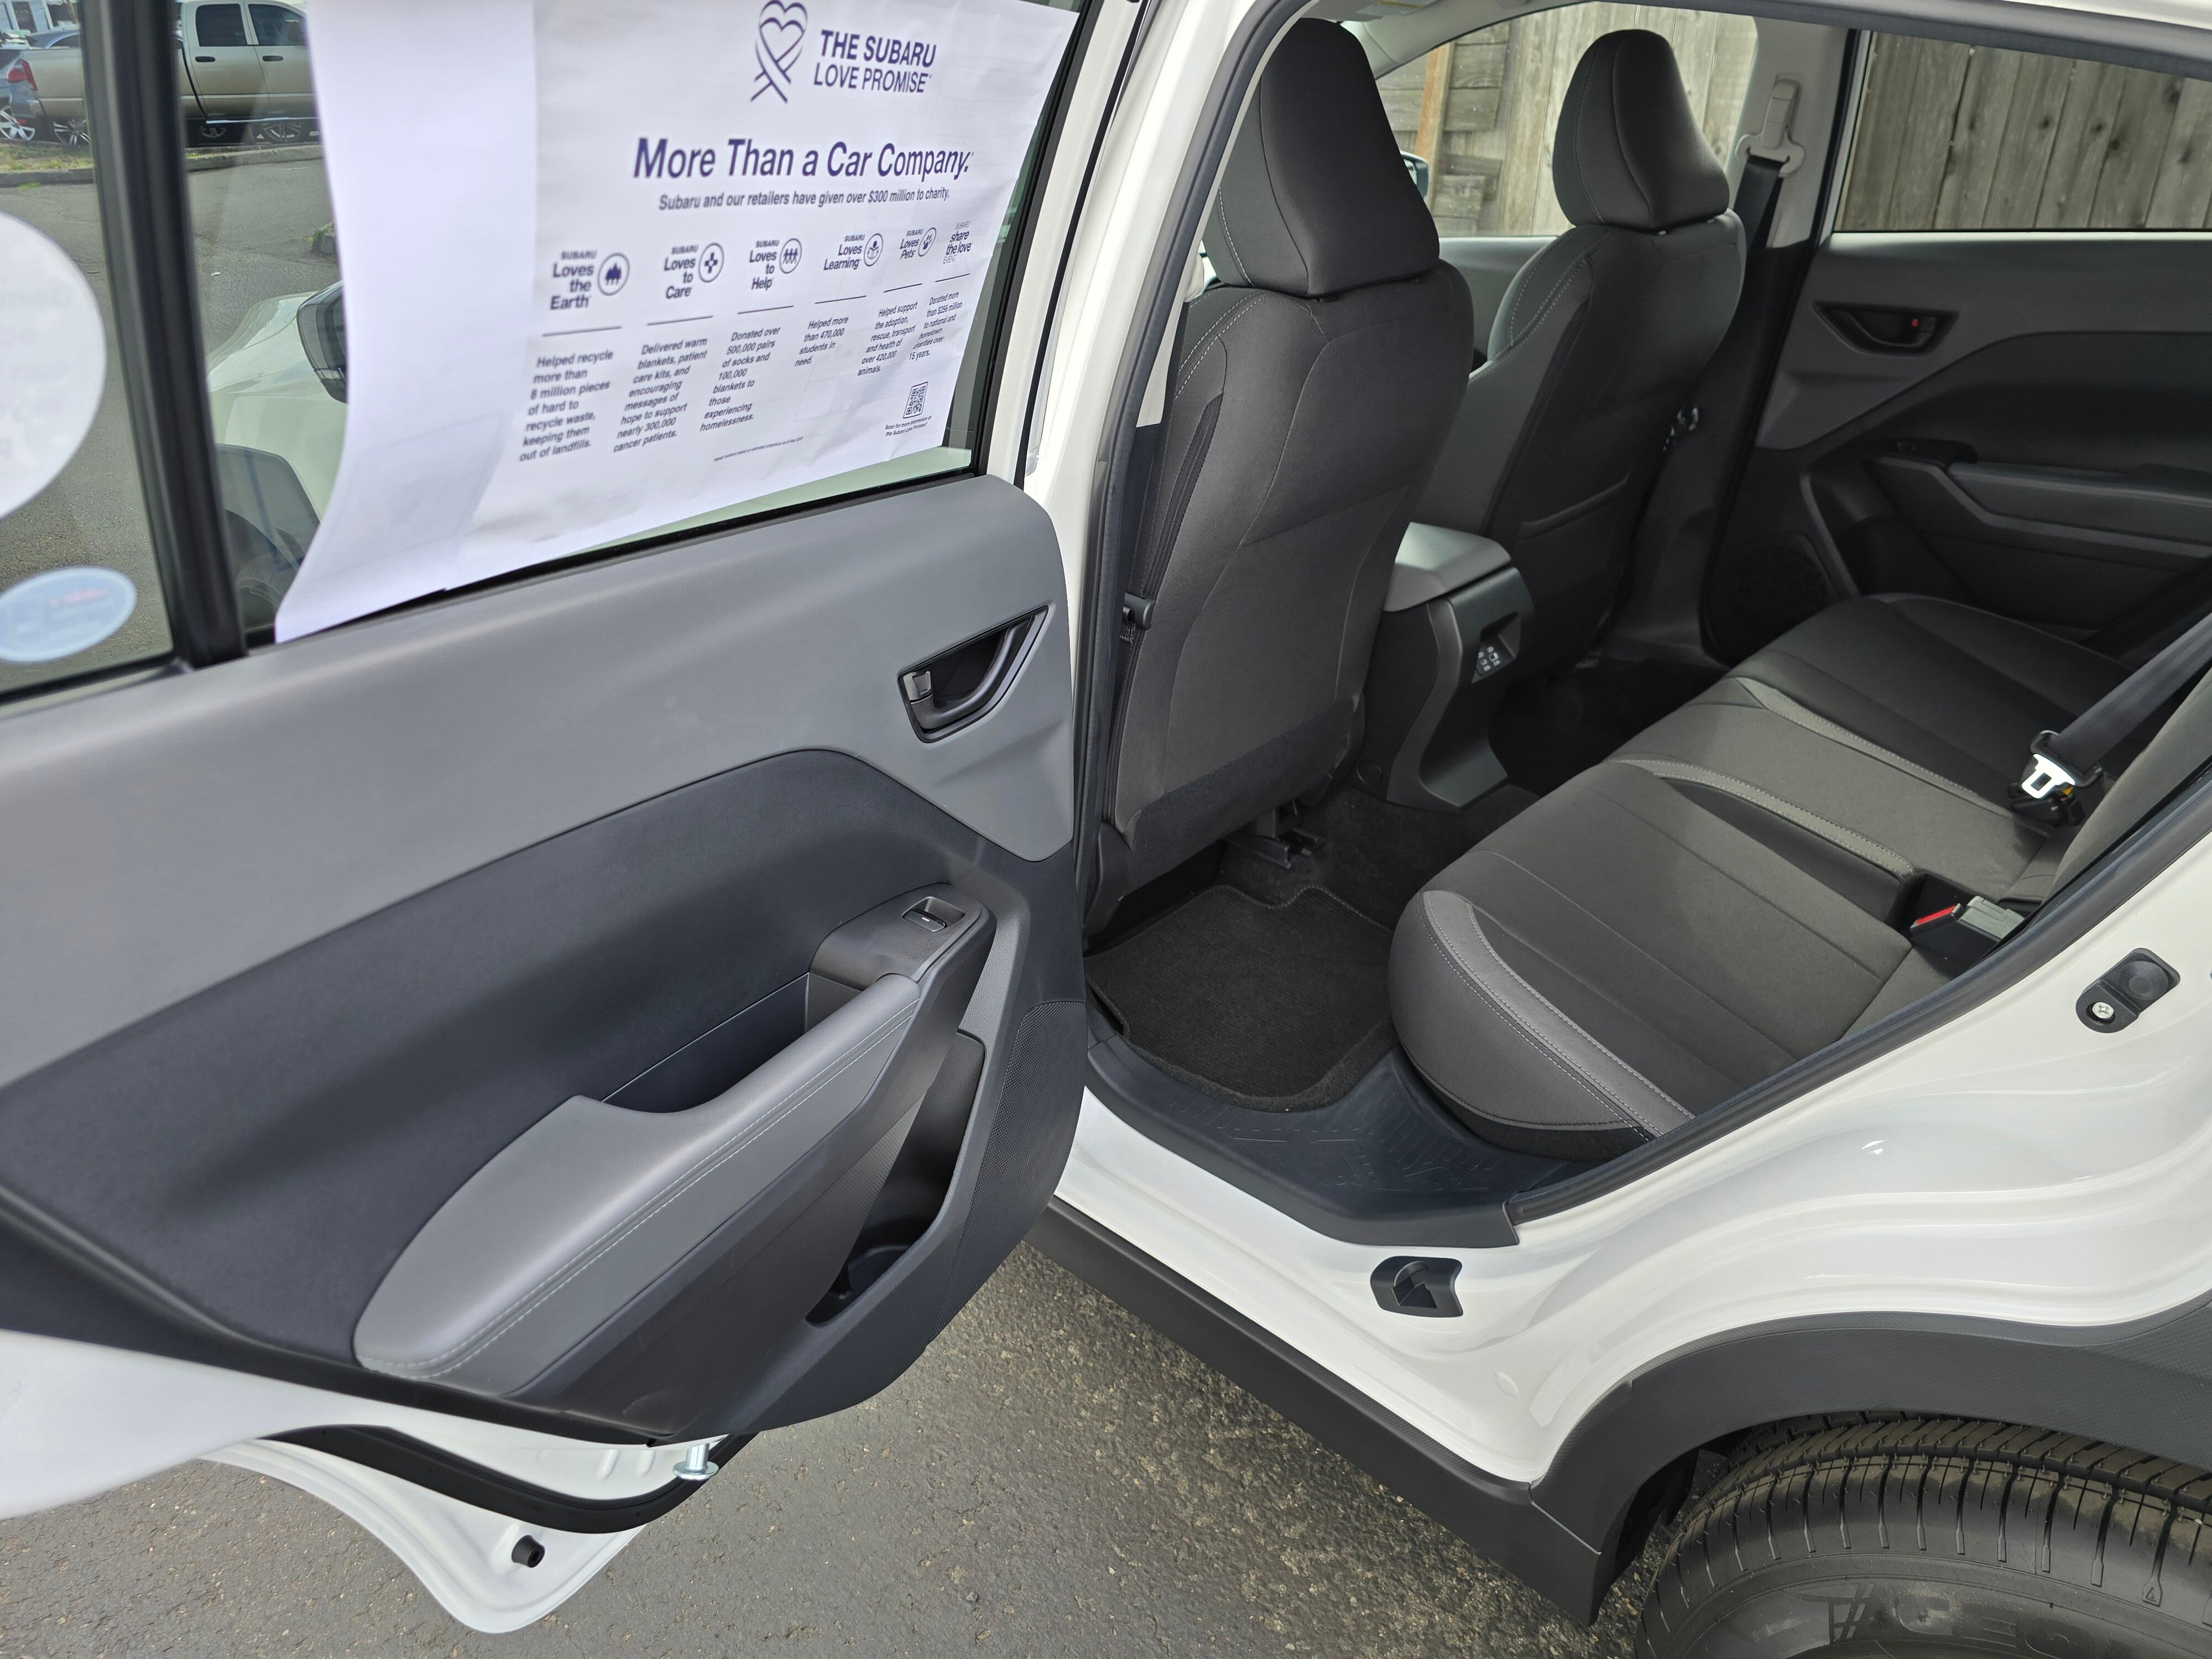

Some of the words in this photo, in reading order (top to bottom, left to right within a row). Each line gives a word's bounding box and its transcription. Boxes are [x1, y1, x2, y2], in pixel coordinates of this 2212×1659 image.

[821, 29, 860, 59] THE
[863, 36, 936, 67] SUBARU
[813, 62, 859, 88] LOVE
[633, 138, 716, 178] More
[727, 139, 794, 176] Than
[802, 150, 818, 176] a
[827, 142, 873, 176] Car
[659, 194, 701, 210] Subaru
[703, 192, 724, 207] and
[727, 195, 744, 205] our
[748, 191, 789, 205] retailers
[792, 191, 816, 205] have
[818, 191, 843, 207] given
[847, 193, 866, 203] over
[868, 190, 888, 204] $300
[889, 190, 915, 202] million
[916, 189, 924, 200] to
[925, 186, 949, 201] charity.
[755, 239, 779, 248] SUBARU
[900, 239, 919, 249] Loves
[950, 231, 969, 243] share
[561, 250, 597, 260] SUBARU
[671, 246, 698, 255] SUBARU
[838, 244, 862, 256] Loves
[900, 249, 915, 260] Pets
[946, 243, 957, 255] the
[957, 242, 971, 253] love
[749, 250, 777, 263] Loves
[823, 257, 860, 270] Learning
[552, 263, 594, 278] Loves
[664, 258, 696, 271] Loves
[766, 263, 774, 274] to
[570, 279, 591, 293] the
[683, 273, 693, 284] to
[751, 277, 773, 291] Help
[666, 286, 691, 299] Care
[929, 293, 948, 306] Donated
[948, 292, 959, 300] more
[550, 294, 590, 310] Earth
[878, 305, 897, 317] Helped
[897, 301, 917, 314] support
[926, 309, 937, 317] than
[948, 301, 963, 311] million
[808, 317, 832, 330] Helped
[832, 317, 849, 326] more
[875, 321, 884, 330] the
[885, 316, 908, 328] adoption,
[928, 316, 948, 327] national
[947, 313, 957, 323] and
[731, 328, 763, 342] Donated
[764, 327, 781, 336] over
[804, 333, 818, 342] than
[820, 327, 844, 340] 470,000
[870, 332, 890, 342] rescue,
[891, 325, 916, 337] transport
[641, 340, 684, 355] Delivered
[685, 338, 707, 348] warm
[727, 342, 756, 355] 500,000
[756, 340, 775, 352] pairs
[799, 343, 828, 354] students
[866, 343, 879, 353] and
[878, 340, 895, 351] health
[896, 338, 903, 346] of
[536, 354, 575, 369] Helped
[577, 348, 613, 364] recycle
[638, 356, 676, 370] blankets,
[678, 350, 707, 365] patient
[722, 358, 732, 368] of
[732, 354, 754, 366] socks
[755, 352, 771, 362] and
[794, 356, 812, 367] need.
[876, 350, 897, 361] 420,000
[909, 352, 916, 360] 15
[916, 350, 930, 361] years.
[533, 373, 561, 384] more
[565, 369, 588, 380] than
[633, 374, 652, 384] care
[655, 371, 671, 382] kits,
[674, 365, 691, 377] and
[718, 368, 748, 381] 100,000
[858, 365, 881, 376] animals.
[530, 389, 537, 400] 8
[540, 386, 576, 399] million
[578, 381, 611, 396] pieces
[629, 380, 682, 398] encouraging
[713, 380, 745, 394] blankets
[528, 404, 539, 416] of
[542, 401, 566, 414] hard
[569, 400, 579, 410] to
[624, 396, 667, 411] messages
[669, 392, 679, 401] of
[708, 396, 731, 407] those
[620, 414, 641, 425] hope
[644, 411, 653, 420] to
[655, 403, 687, 417] support
[704, 403, 753, 420] experiencing
[526, 417, 563, 432] recycle
[566, 411, 596, 425] waste,
[617, 426, 643, 440] nearly
[644, 416, 676, 432] 300,000
[700, 413, 754, 432] homelessness.
[523, 431, 563, 447] keeping
[566, 426, 589, 439] them
[613, 439, 642, 453] cancer
[643, 430, 677, 447] patients.
[519, 450, 537, 462] out
[539, 447, 550, 458] of
[552, 439, 591, 455] landfills.
